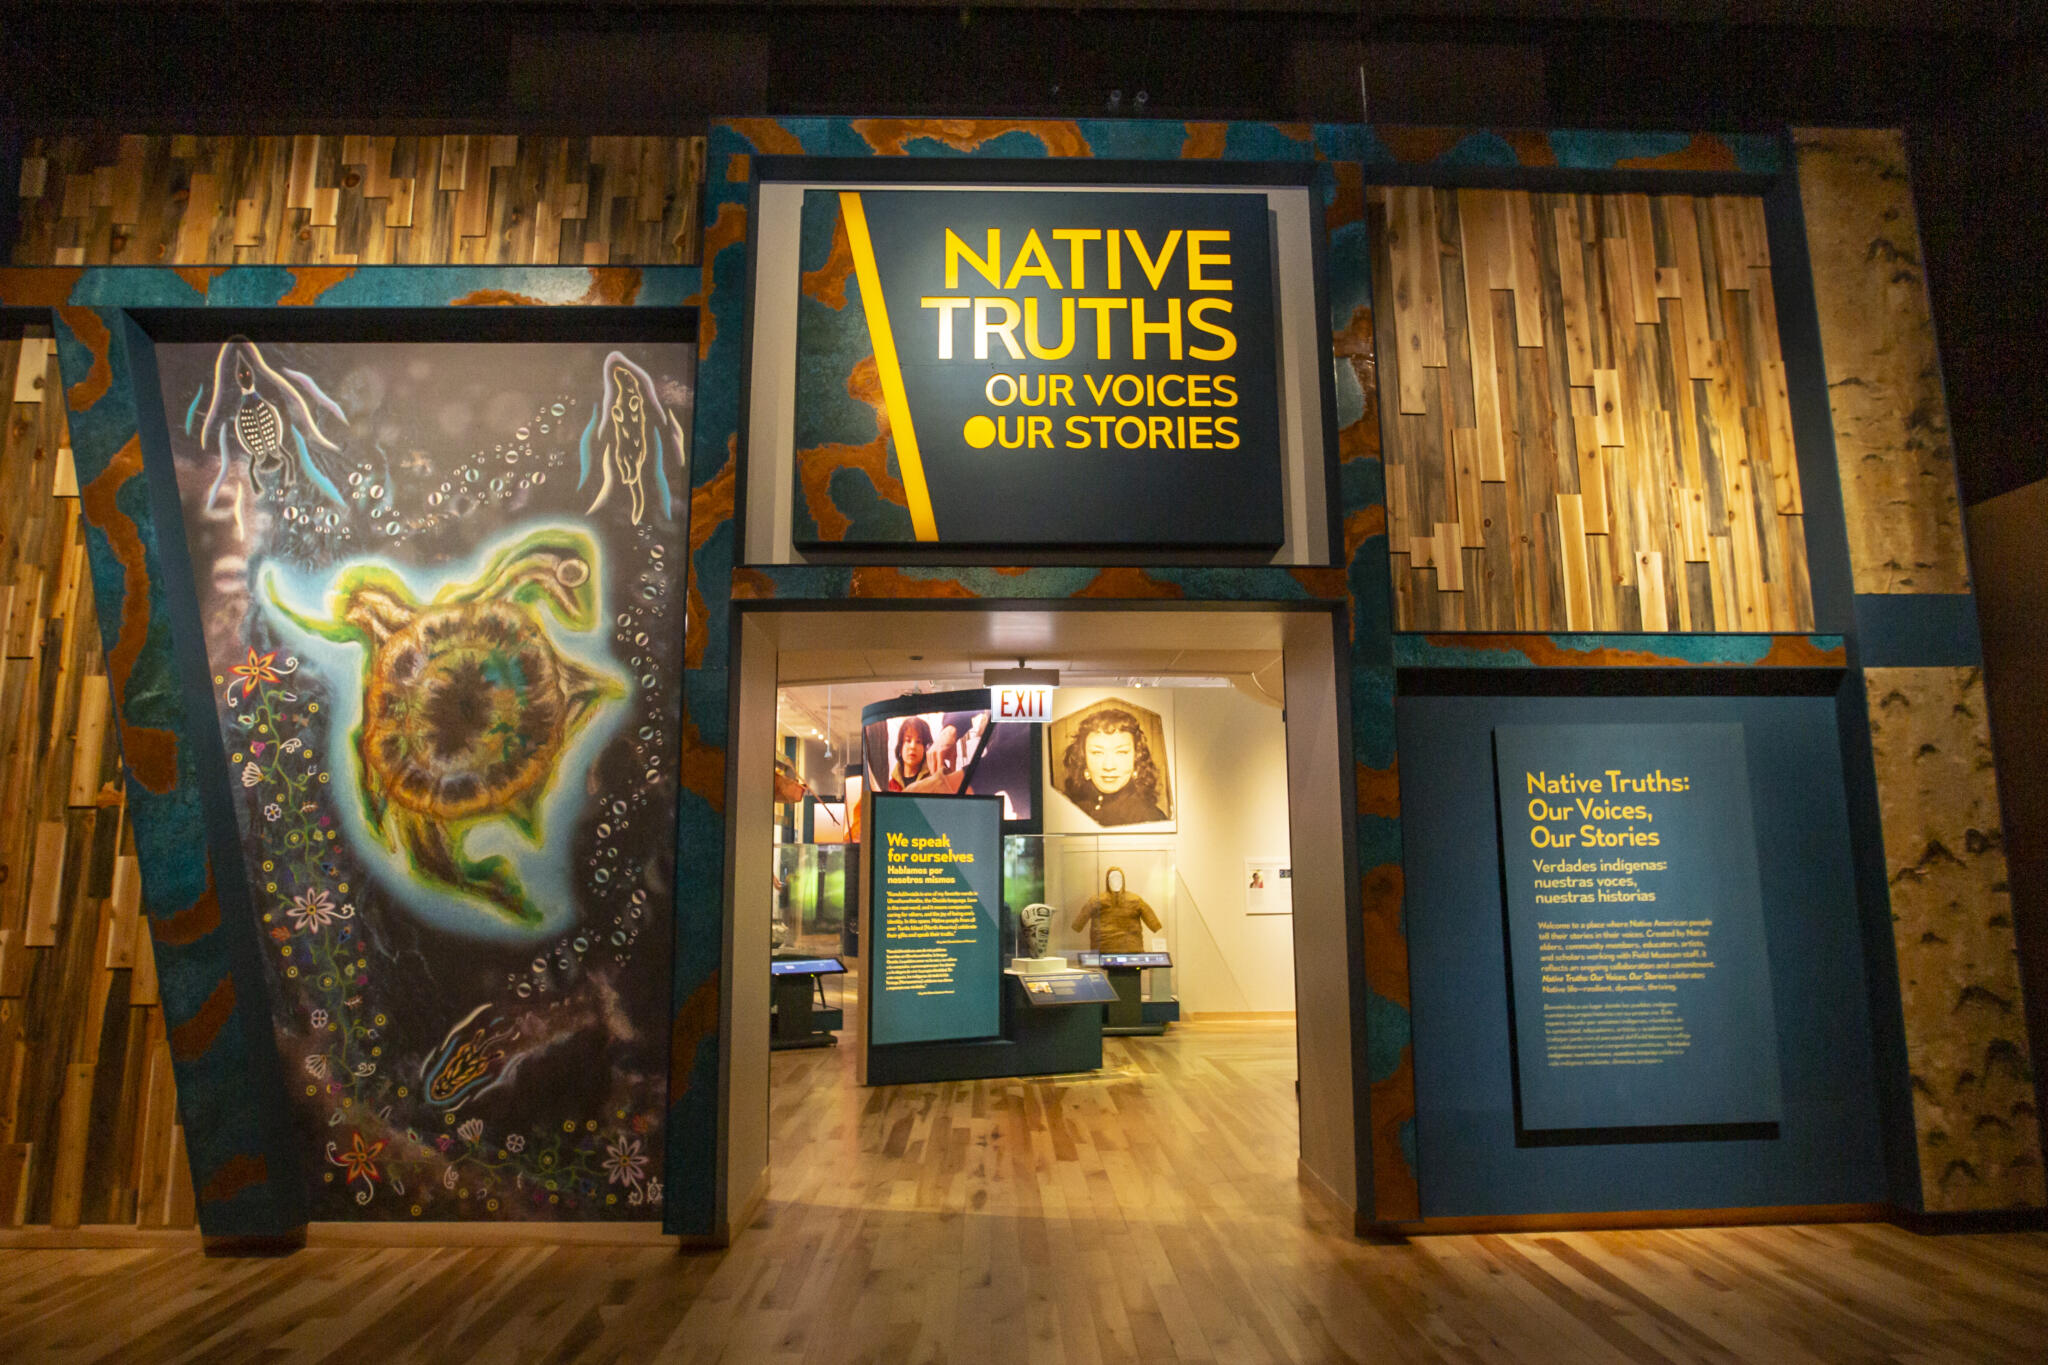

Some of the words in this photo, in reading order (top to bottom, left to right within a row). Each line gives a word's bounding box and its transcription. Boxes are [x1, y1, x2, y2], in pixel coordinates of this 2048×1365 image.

[945, 227, 1233, 291] NATIVE
[921, 296, 1237, 361] TRUTHS
[985, 374, 1076, 407] OUR
[1083, 374, 1238, 408] VOICES
[1065, 416, 1240, 450] STORIES
[1001, 689, 1045, 717] EXIT
[1526, 771, 1602, 794] Native
[1605, 770, 1690, 792] Truths:
[1528, 799, 1574, 821] Our
[1576, 798, 1653, 822] Voices,
[886, 832, 909, 847] We
[912, 833, 951, 850] speak
[1530, 825, 1576, 848] Our
[1580, 825, 1660, 847] Stories
[888, 848, 909, 862] for
[910, 849, 974, 862] ourselves
[1532, 859, 1597, 873] Verdades
[1600, 858, 1667, 874] indígenas:
[1534, 876, 1594, 888] nuestras
[1597, 877, 1637, 888] voces,
[1535, 891, 1595, 903] nuestras
[1598, 889, 1656, 903] historias
